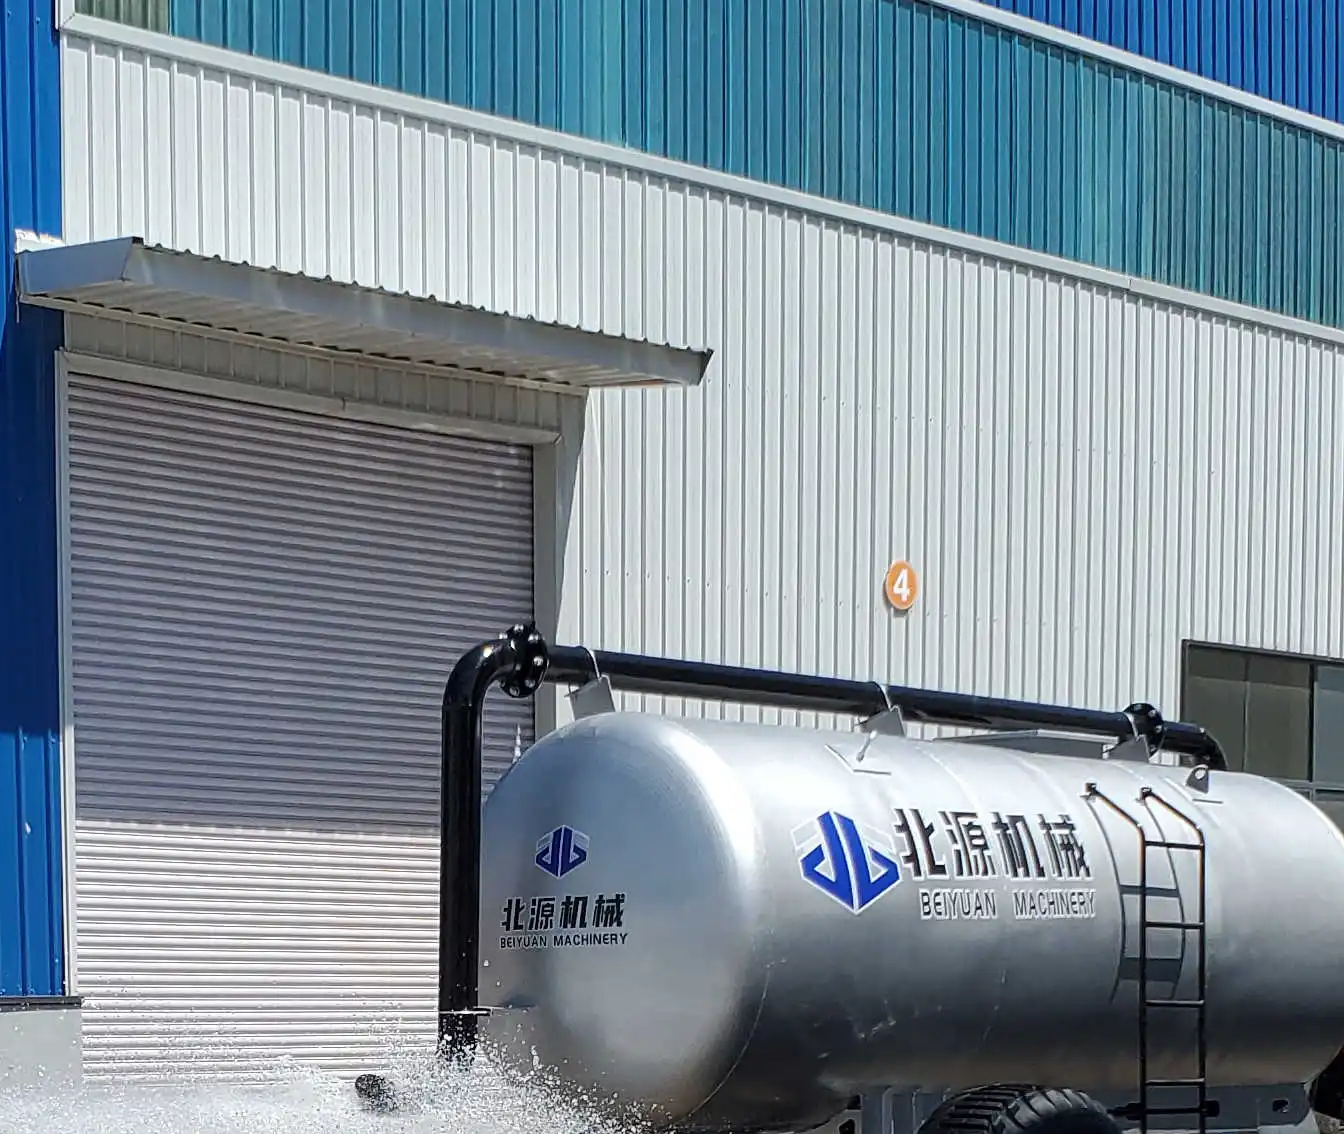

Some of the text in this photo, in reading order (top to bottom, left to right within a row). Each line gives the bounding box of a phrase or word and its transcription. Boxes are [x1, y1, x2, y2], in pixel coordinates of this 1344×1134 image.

[892, 568, 910, 602] 4
[894, 808, 1092, 878] 北源机械
[501, 893, 625, 931] 北源机械
[920, 890, 1095, 917] BEIYUAN MACHINERY
[500, 933, 628, 948] BEIYUAN MACHINERY
